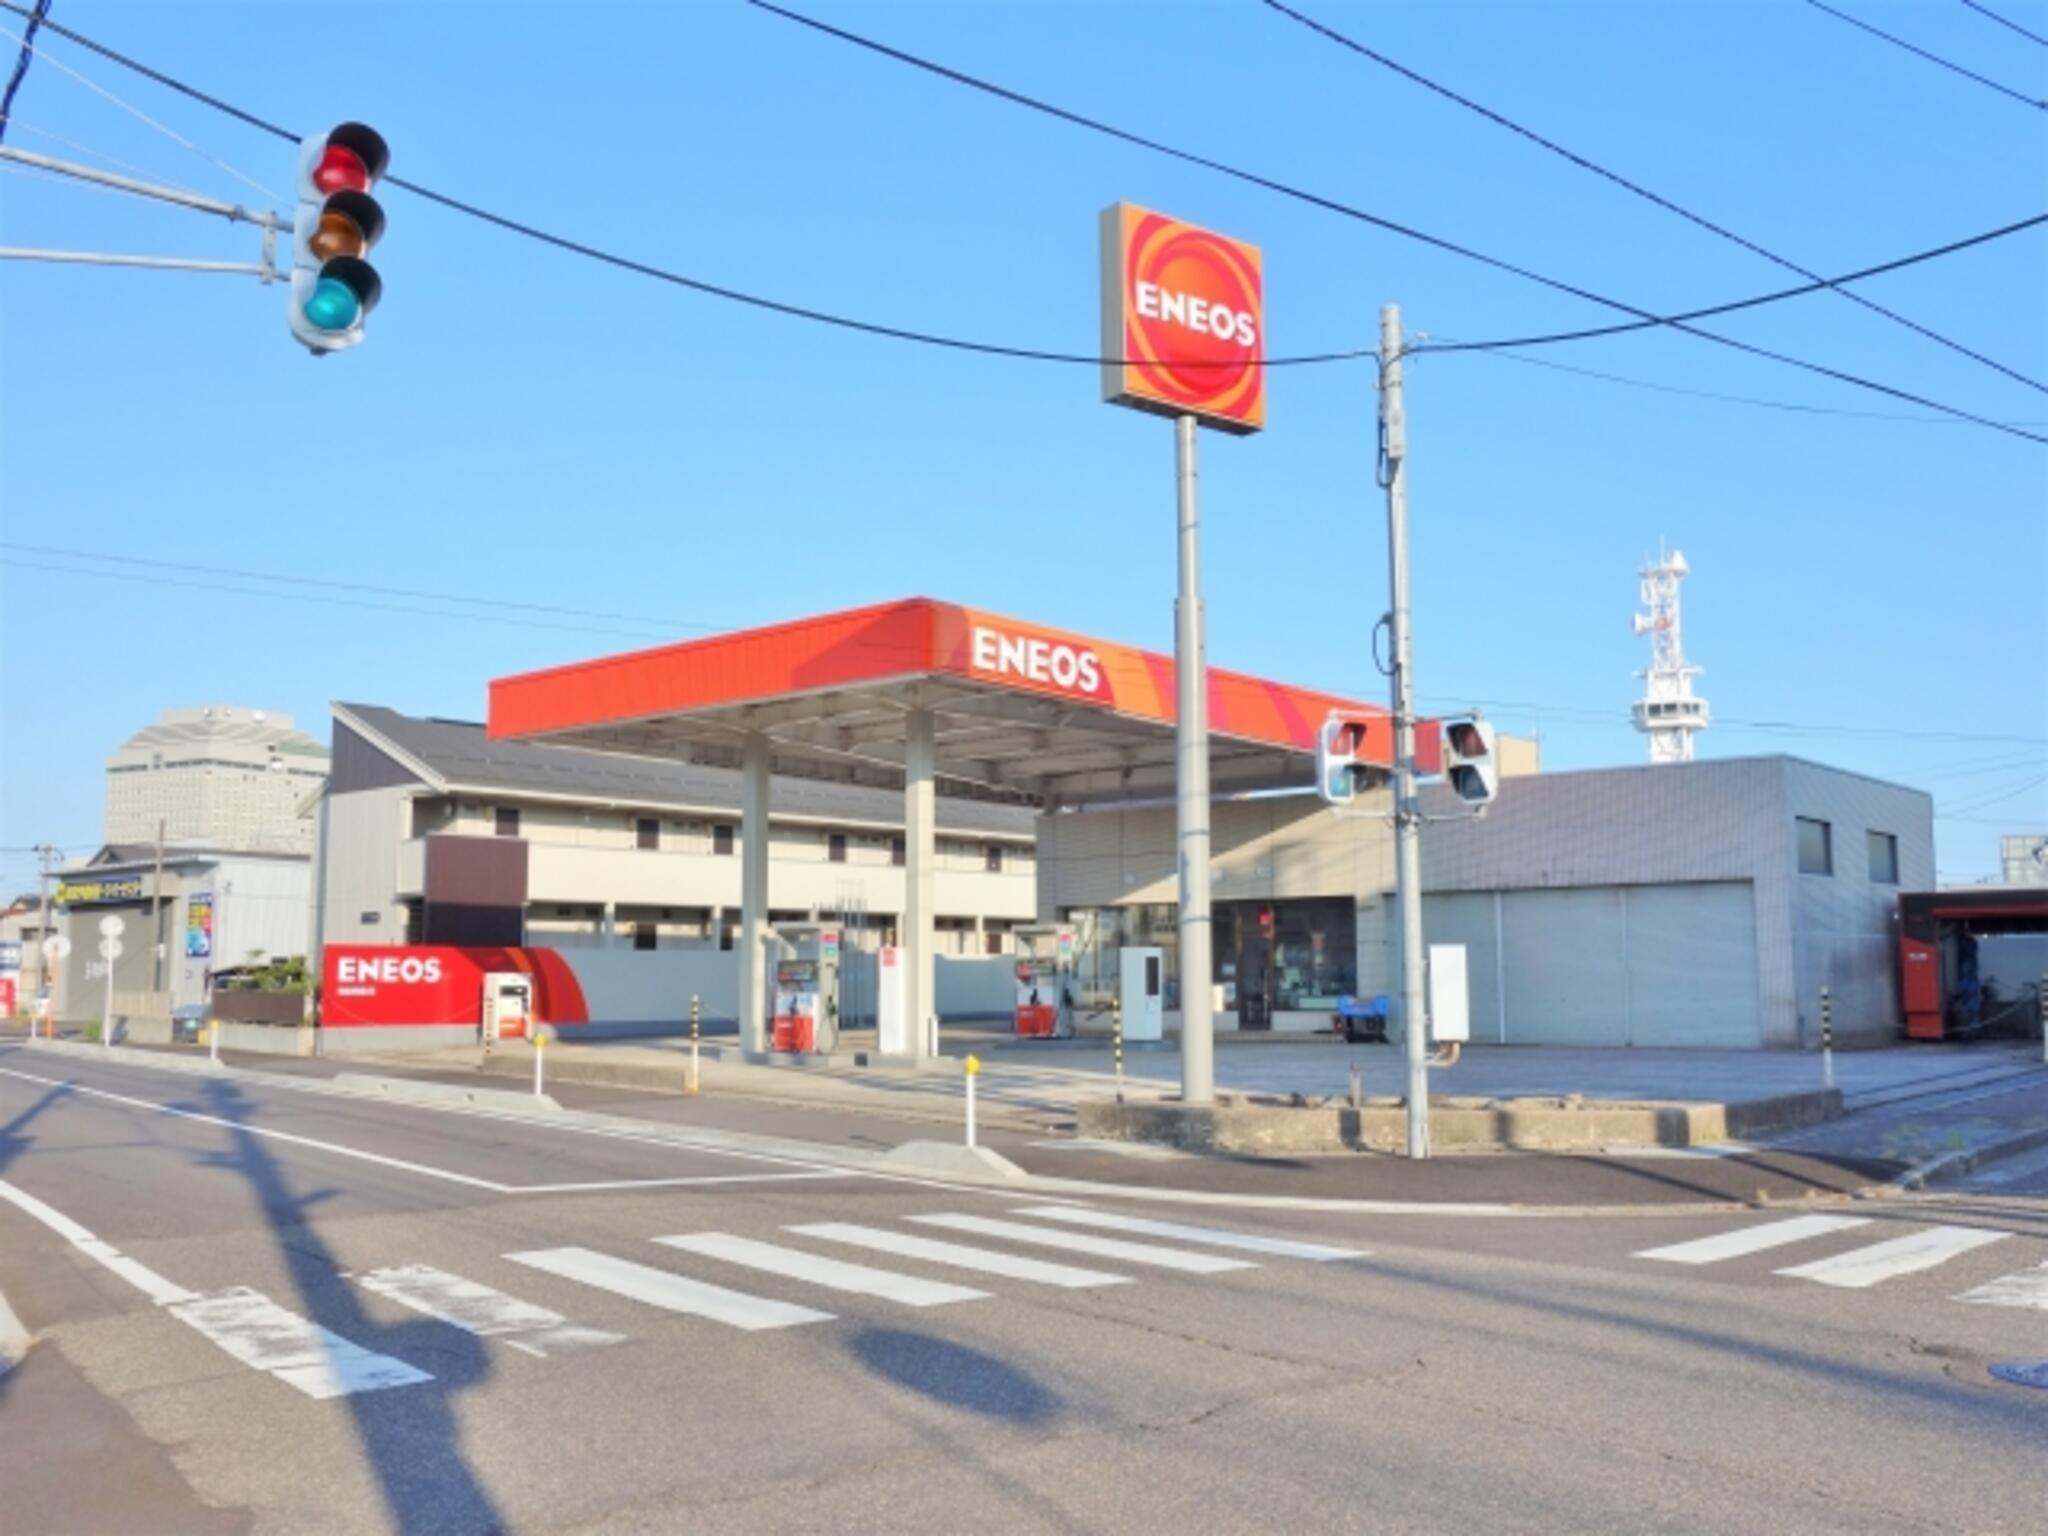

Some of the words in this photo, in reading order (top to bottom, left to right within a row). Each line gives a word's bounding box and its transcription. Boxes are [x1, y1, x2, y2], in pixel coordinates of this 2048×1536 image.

[1135, 281, 1256, 347] ENEOS
[972, 626, 1100, 693] ENEOS
[337, 956, 442, 983] ENEOS
